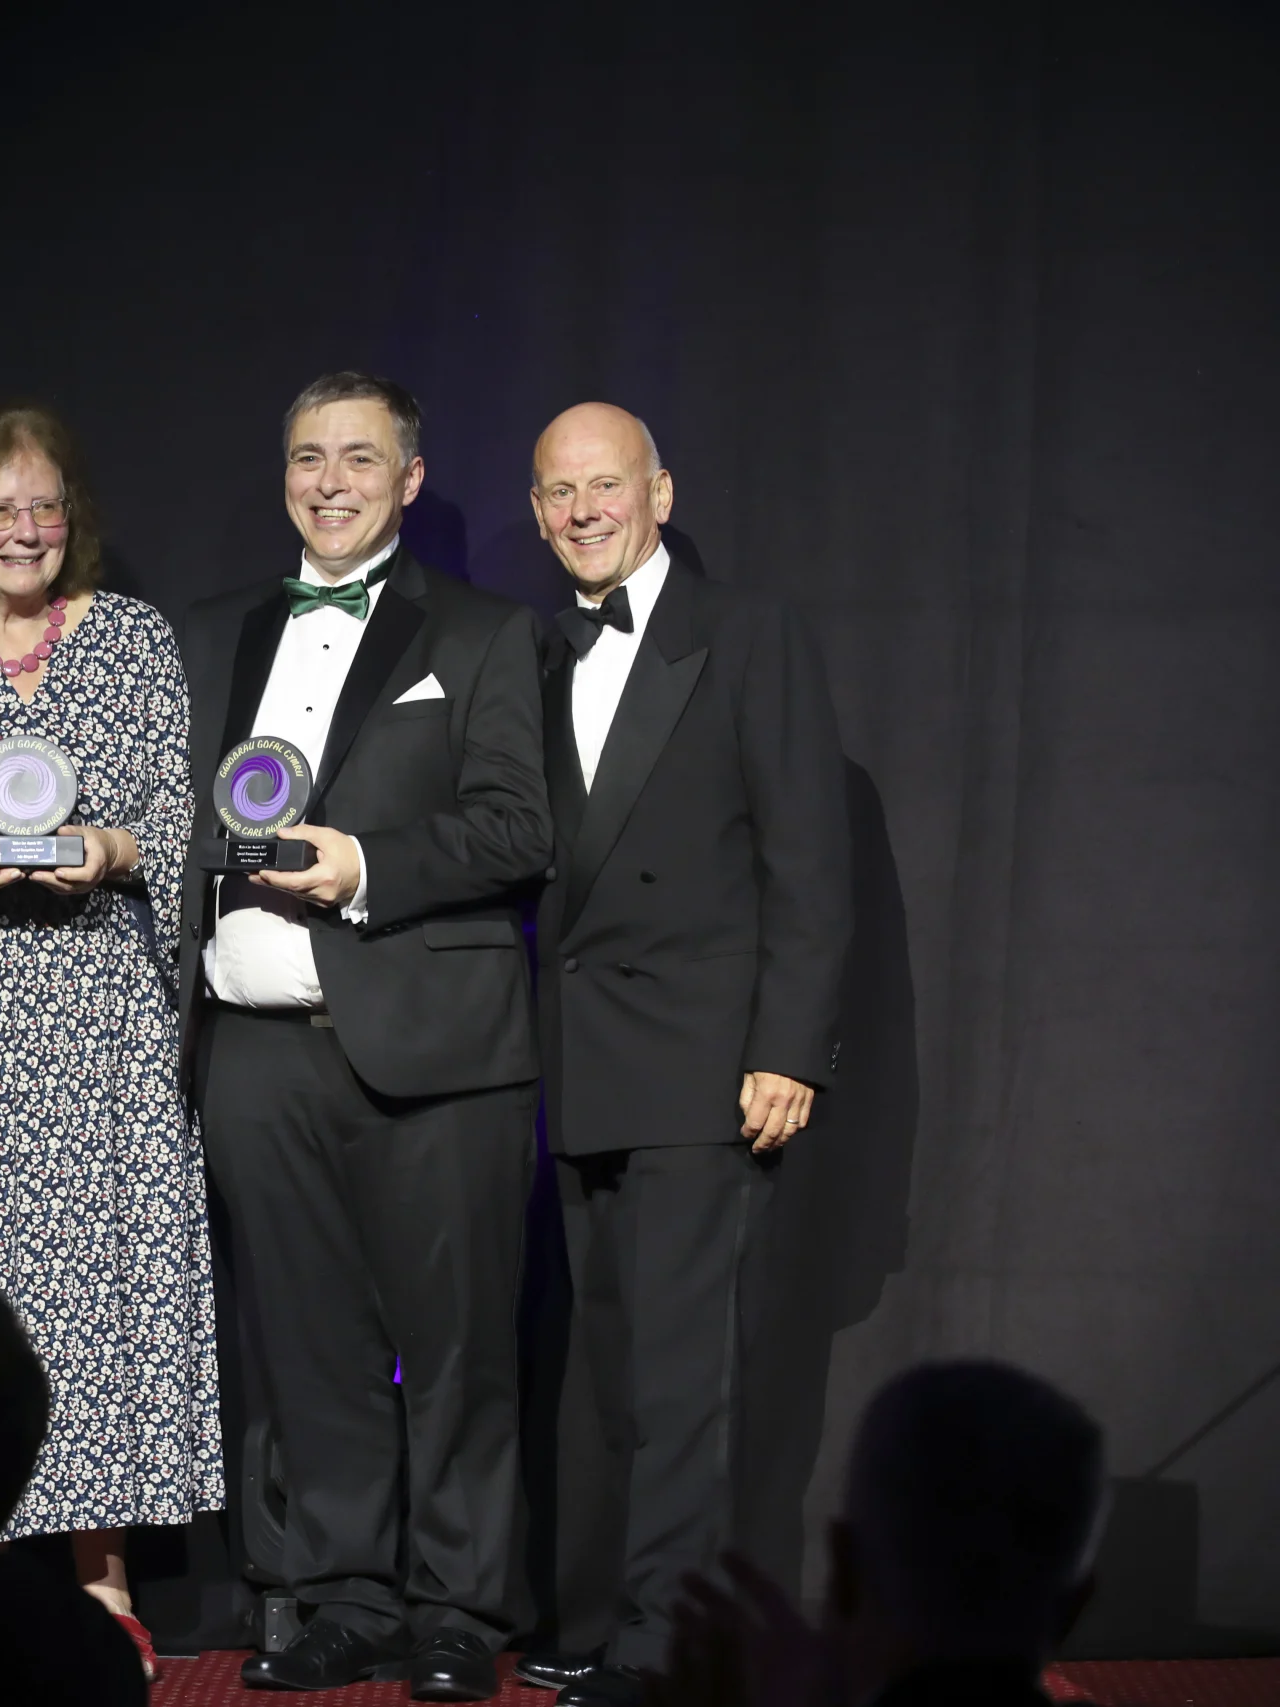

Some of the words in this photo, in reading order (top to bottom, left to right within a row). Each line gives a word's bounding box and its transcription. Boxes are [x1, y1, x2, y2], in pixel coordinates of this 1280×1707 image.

[17, 739, 47, 753] GOFAL
[47, 750, 72, 777] CYMRU
[257, 739, 286, 753] GOFAL
[283, 749, 304, 777] CYMRU
[7, 825, 32, 835] CARE
[33, 806, 67, 834] AWARDS
[219, 807, 241, 832] WALES
[241, 826, 263, 837] CARE
[265, 807, 297, 836] AWARDS
